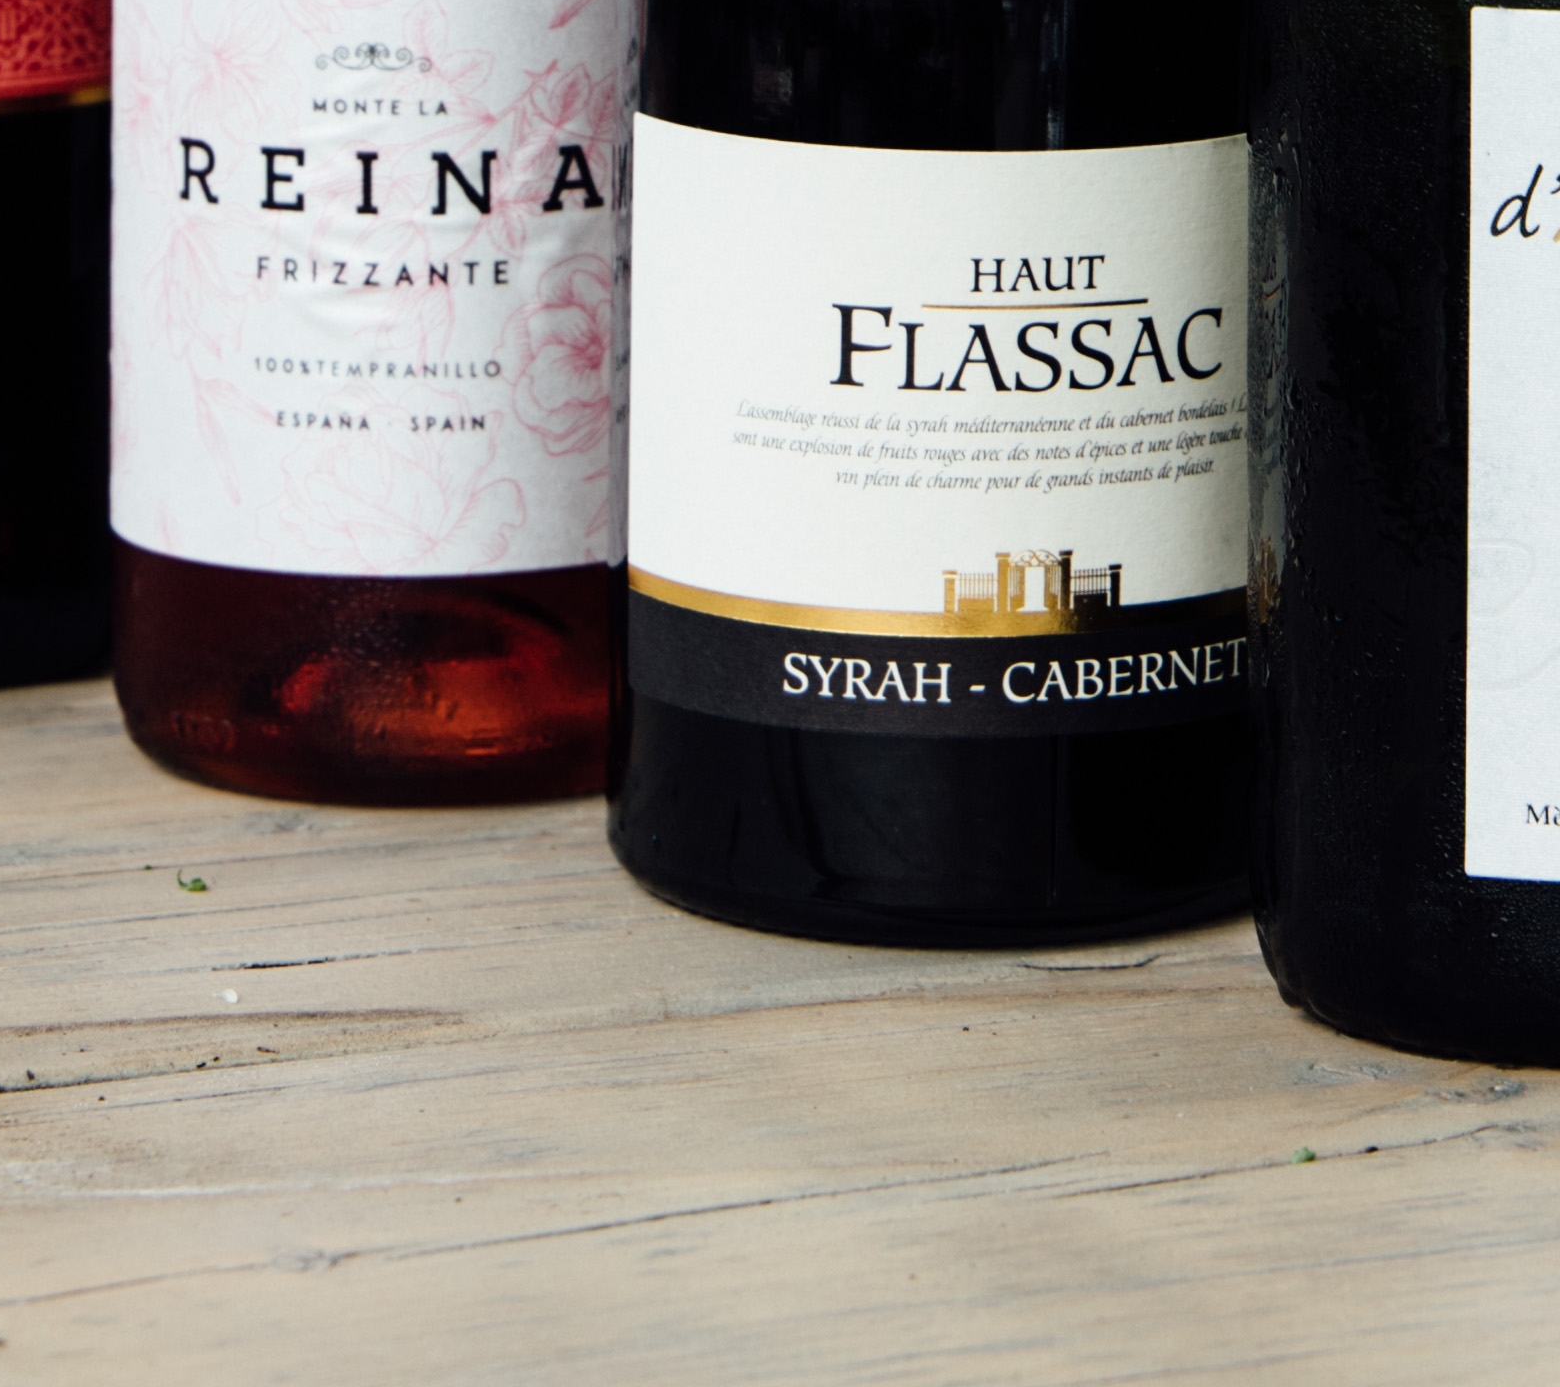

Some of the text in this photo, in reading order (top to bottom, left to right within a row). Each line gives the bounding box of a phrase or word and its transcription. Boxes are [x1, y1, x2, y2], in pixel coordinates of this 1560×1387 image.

[312, 98, 450, 117] MONTE LA
[178, 137, 605, 216] REINA
[255, 256, 511, 287] FRIZZANTE
[969, 254, 1106, 294] HAUT
[828, 301, 1225, 394] FLASSAC
[275, 409, 487, 433] ESPAÑA SPAIN
[821, 411, 861, 430] réussi
[864, 410, 883, 431] de
[886, 409, 901, 432] la
[906, 414, 948, 438] syrah
[953, 413, 1074, 435] méditerranéenne
[1079, 415, 1092, 432] et
[1096, 410, 1115, 430] du
[1119, 406, 1175, 428] cabernet
[1177, 396, 1229, 422] bordelais
[731, 429, 758, 447] sont
[761, 434, 787, 450] une
[789, 435, 852, 459] explosion
[857, 438, 875, 459] de
[873, 439, 919, 464] fruits
[923, 446, 967, 467] rouges
[971, 446, 1004, 463] avec
[1007, 442, 1030, 462] des
[1035, 443, 1071, 461] notes
[1075, 439, 1127, 463] d'épices
[1131, 438, 1144, 456] et
[1148, 435, 1173, 453] une
[1175, 427, 1206, 456] légère
[835, 468, 859, 486] vin
[862, 467, 900, 490] plein
[905, 468, 923, 489] de
[926, 469, 983, 490] charme
[984, 475, 1022, 494] pour
[1025, 470, 1042, 489] de
[1042, 469, 1094, 494] grands
[1098, 464, 1155, 485] instants
[1157, 460, 1173, 481] de
[781, 652, 952, 704] SYRAH
[1000, 636, 1248, 704] CABERNET
